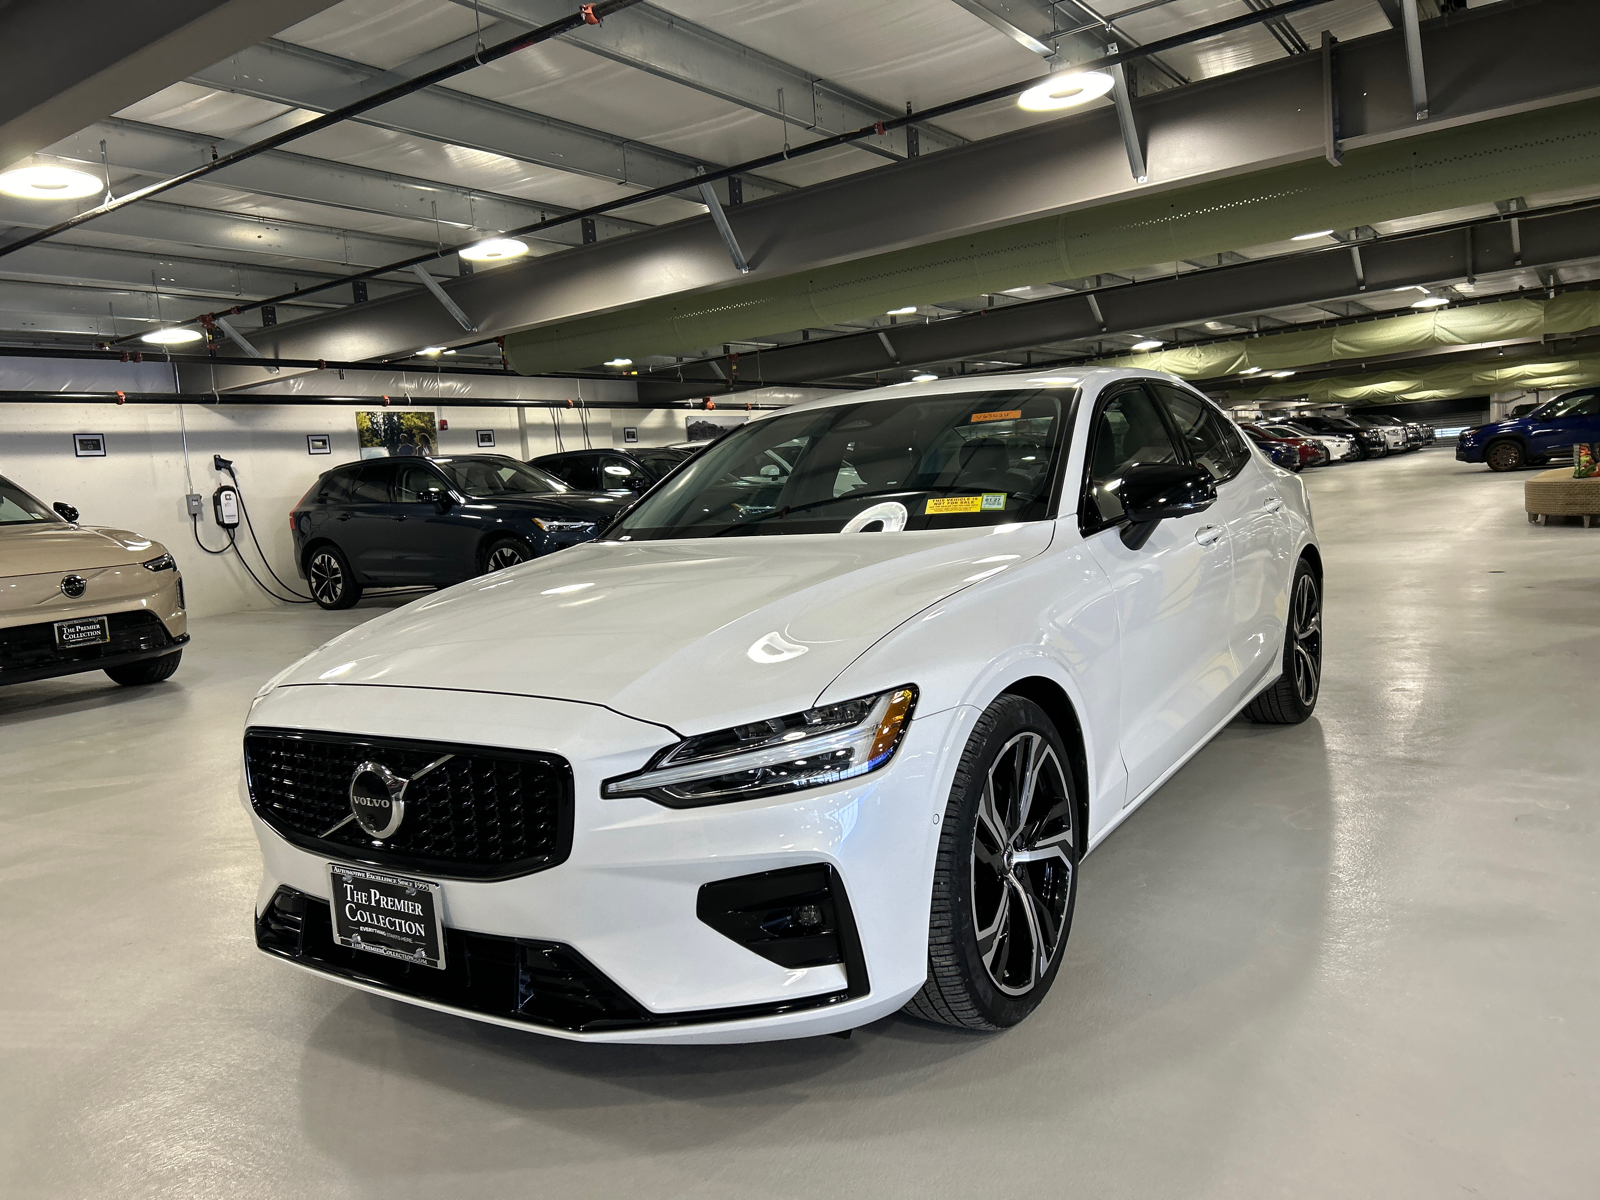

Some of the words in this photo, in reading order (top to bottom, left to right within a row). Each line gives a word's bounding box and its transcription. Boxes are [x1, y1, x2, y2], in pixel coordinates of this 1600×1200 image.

[75, 624, 101, 632] PREMIER
[63, 630, 102, 640] COLLECTION
[353, 795, 390, 808] VOLVO
[343, 883, 369, 905] THE
[369, 888, 424, 916] PREMIER
[345, 903, 426, 937] COLLECTION
[359, 926, 387, 936] EVERYTHING
